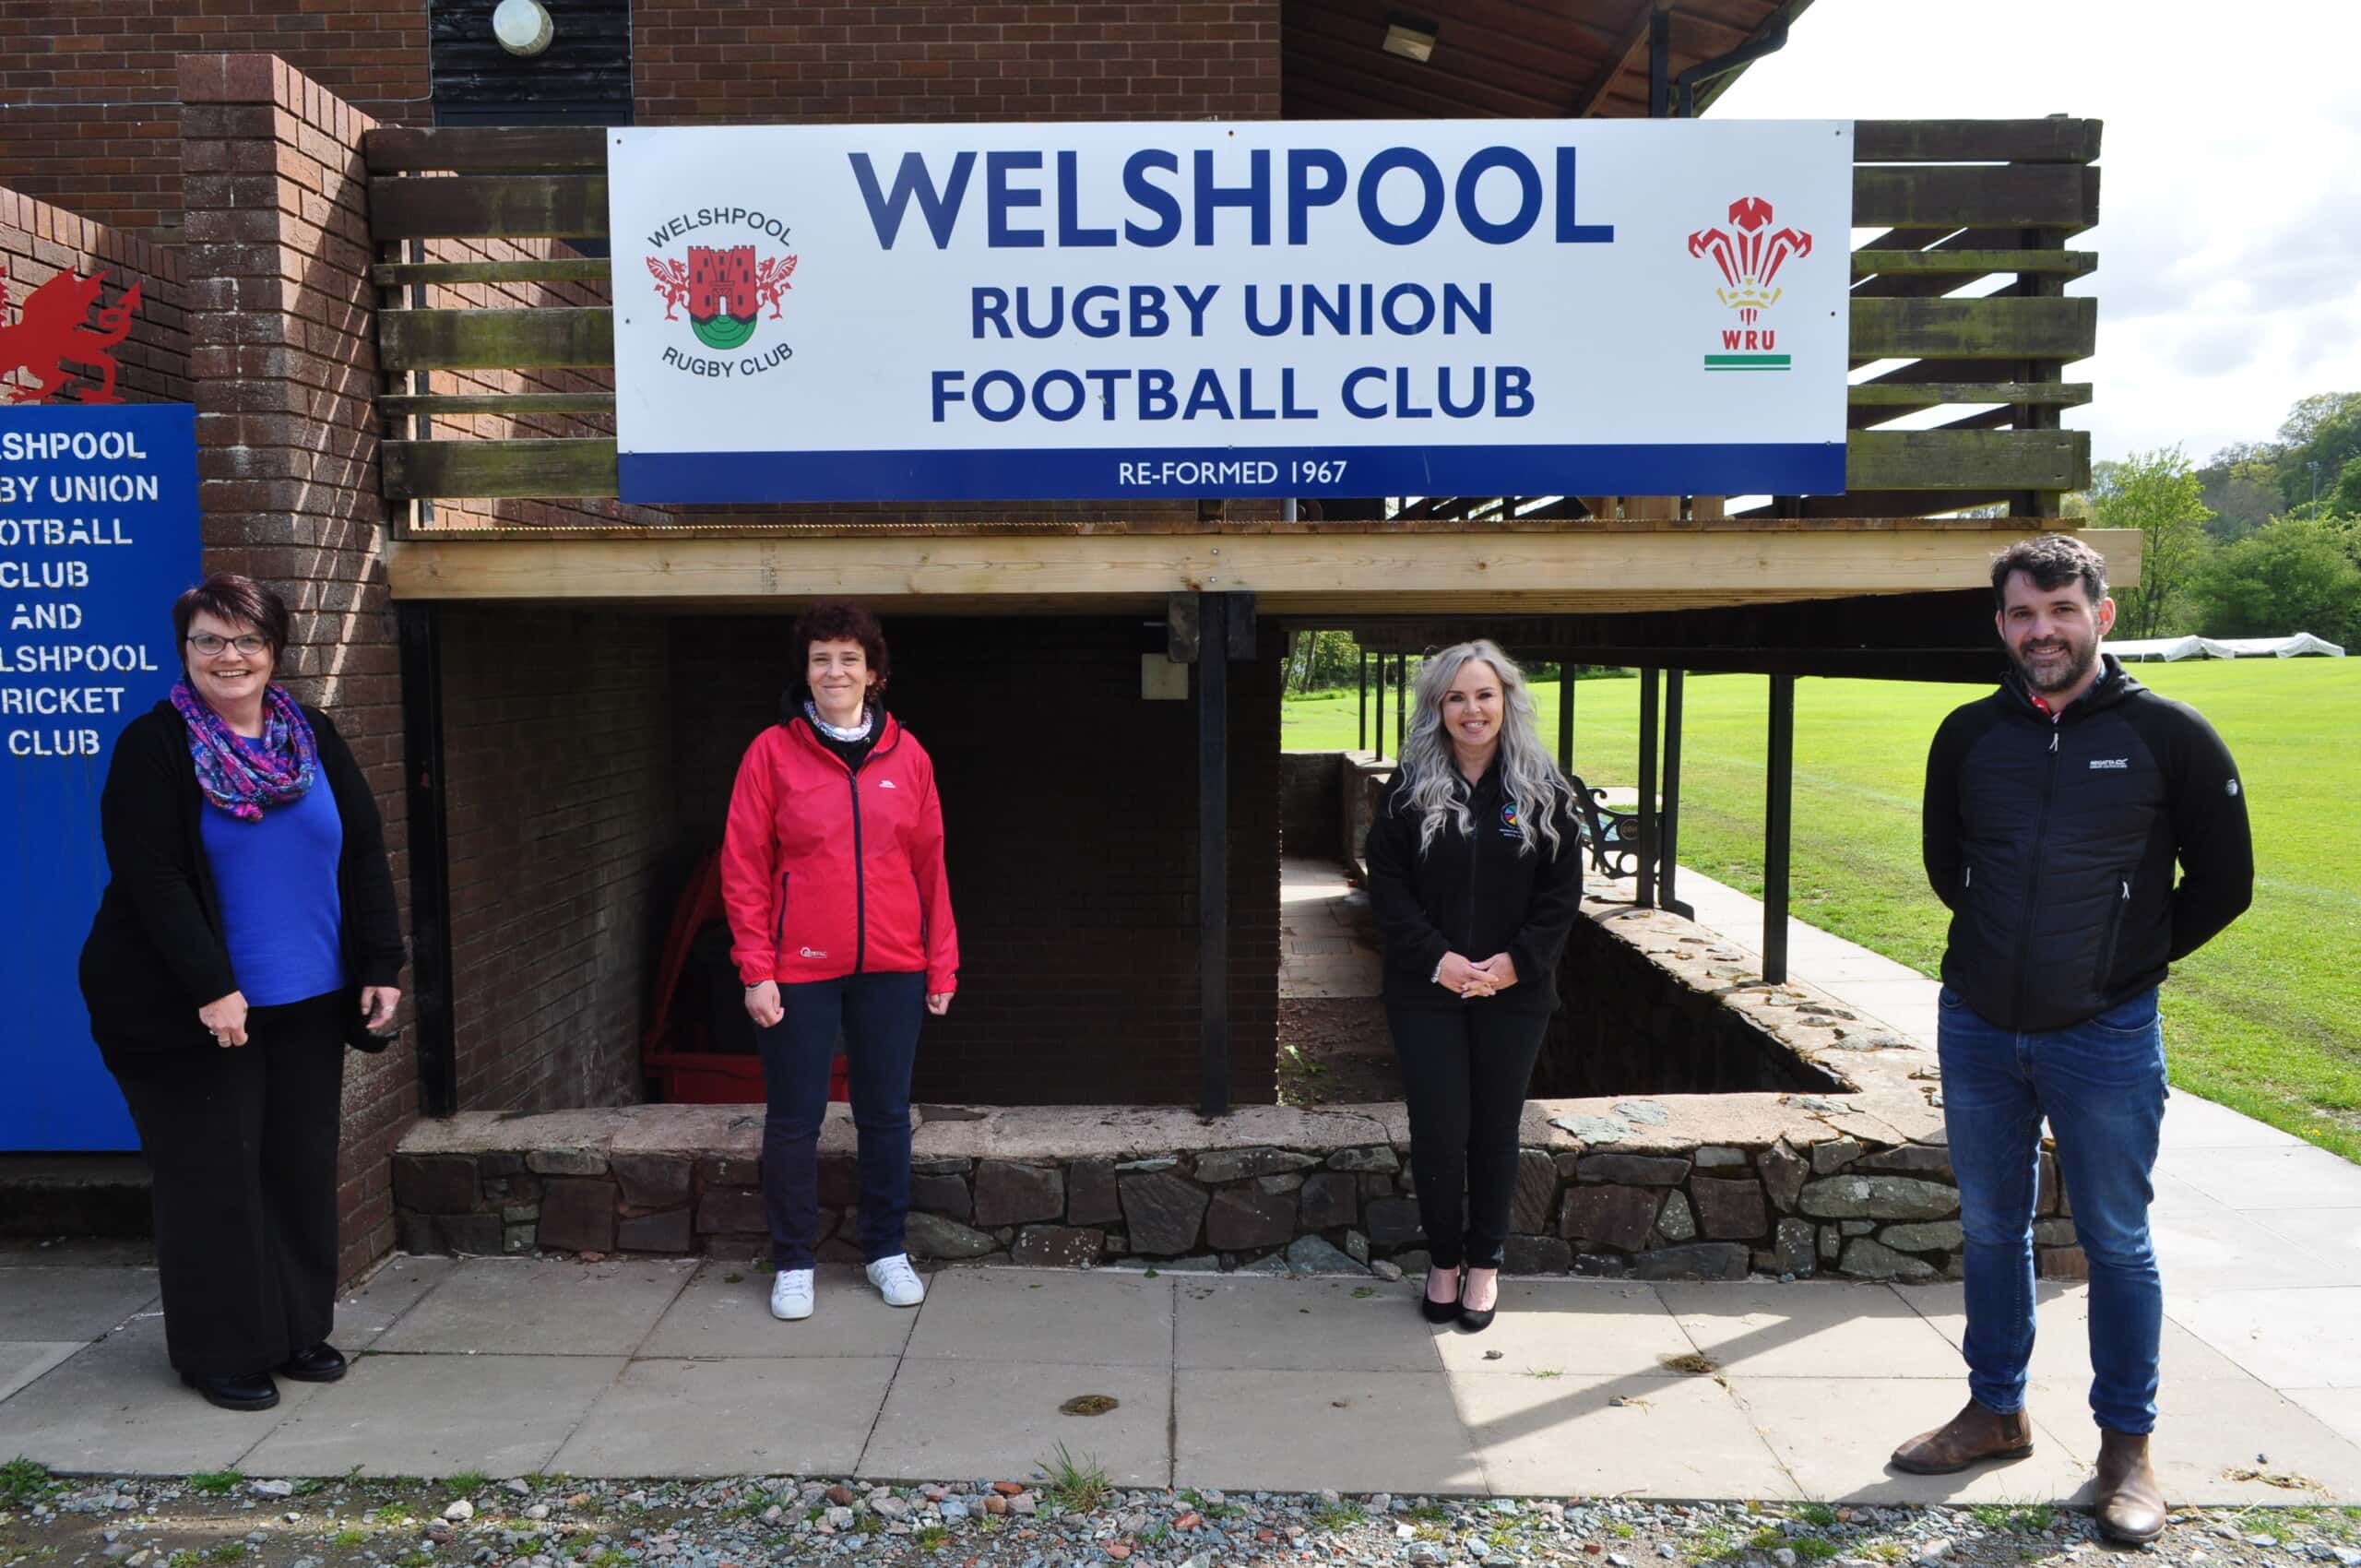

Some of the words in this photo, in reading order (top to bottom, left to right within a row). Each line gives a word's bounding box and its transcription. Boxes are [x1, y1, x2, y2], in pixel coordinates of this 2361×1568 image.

[848, 146, 1615, 251] WELSHPOOL
[647, 207, 791, 248] WELSHPOOL
[971, 284, 1221, 339] RUGBY
[1244, 282, 1492, 338] UNION
[1722, 329, 1775, 350] WRU
[661, 346, 735, 378] RUGBY
[740, 342, 794, 376] CLUB
[931, 367, 1319, 422] FOOTBALL
[1341, 365, 1535, 420] CLUB
[0, 432, 148, 461] SHPOOL
[1119, 461, 1278, 485] RE-FORMED
[1291, 460, 1348, 484] 1967
[50, 474, 159, 503] UNION
[0, 561, 89, 588] CLUB
[10, 602, 82, 630] AND
[0, 687, 125, 715] RICKET
[8, 729, 101, 756] CLUB
